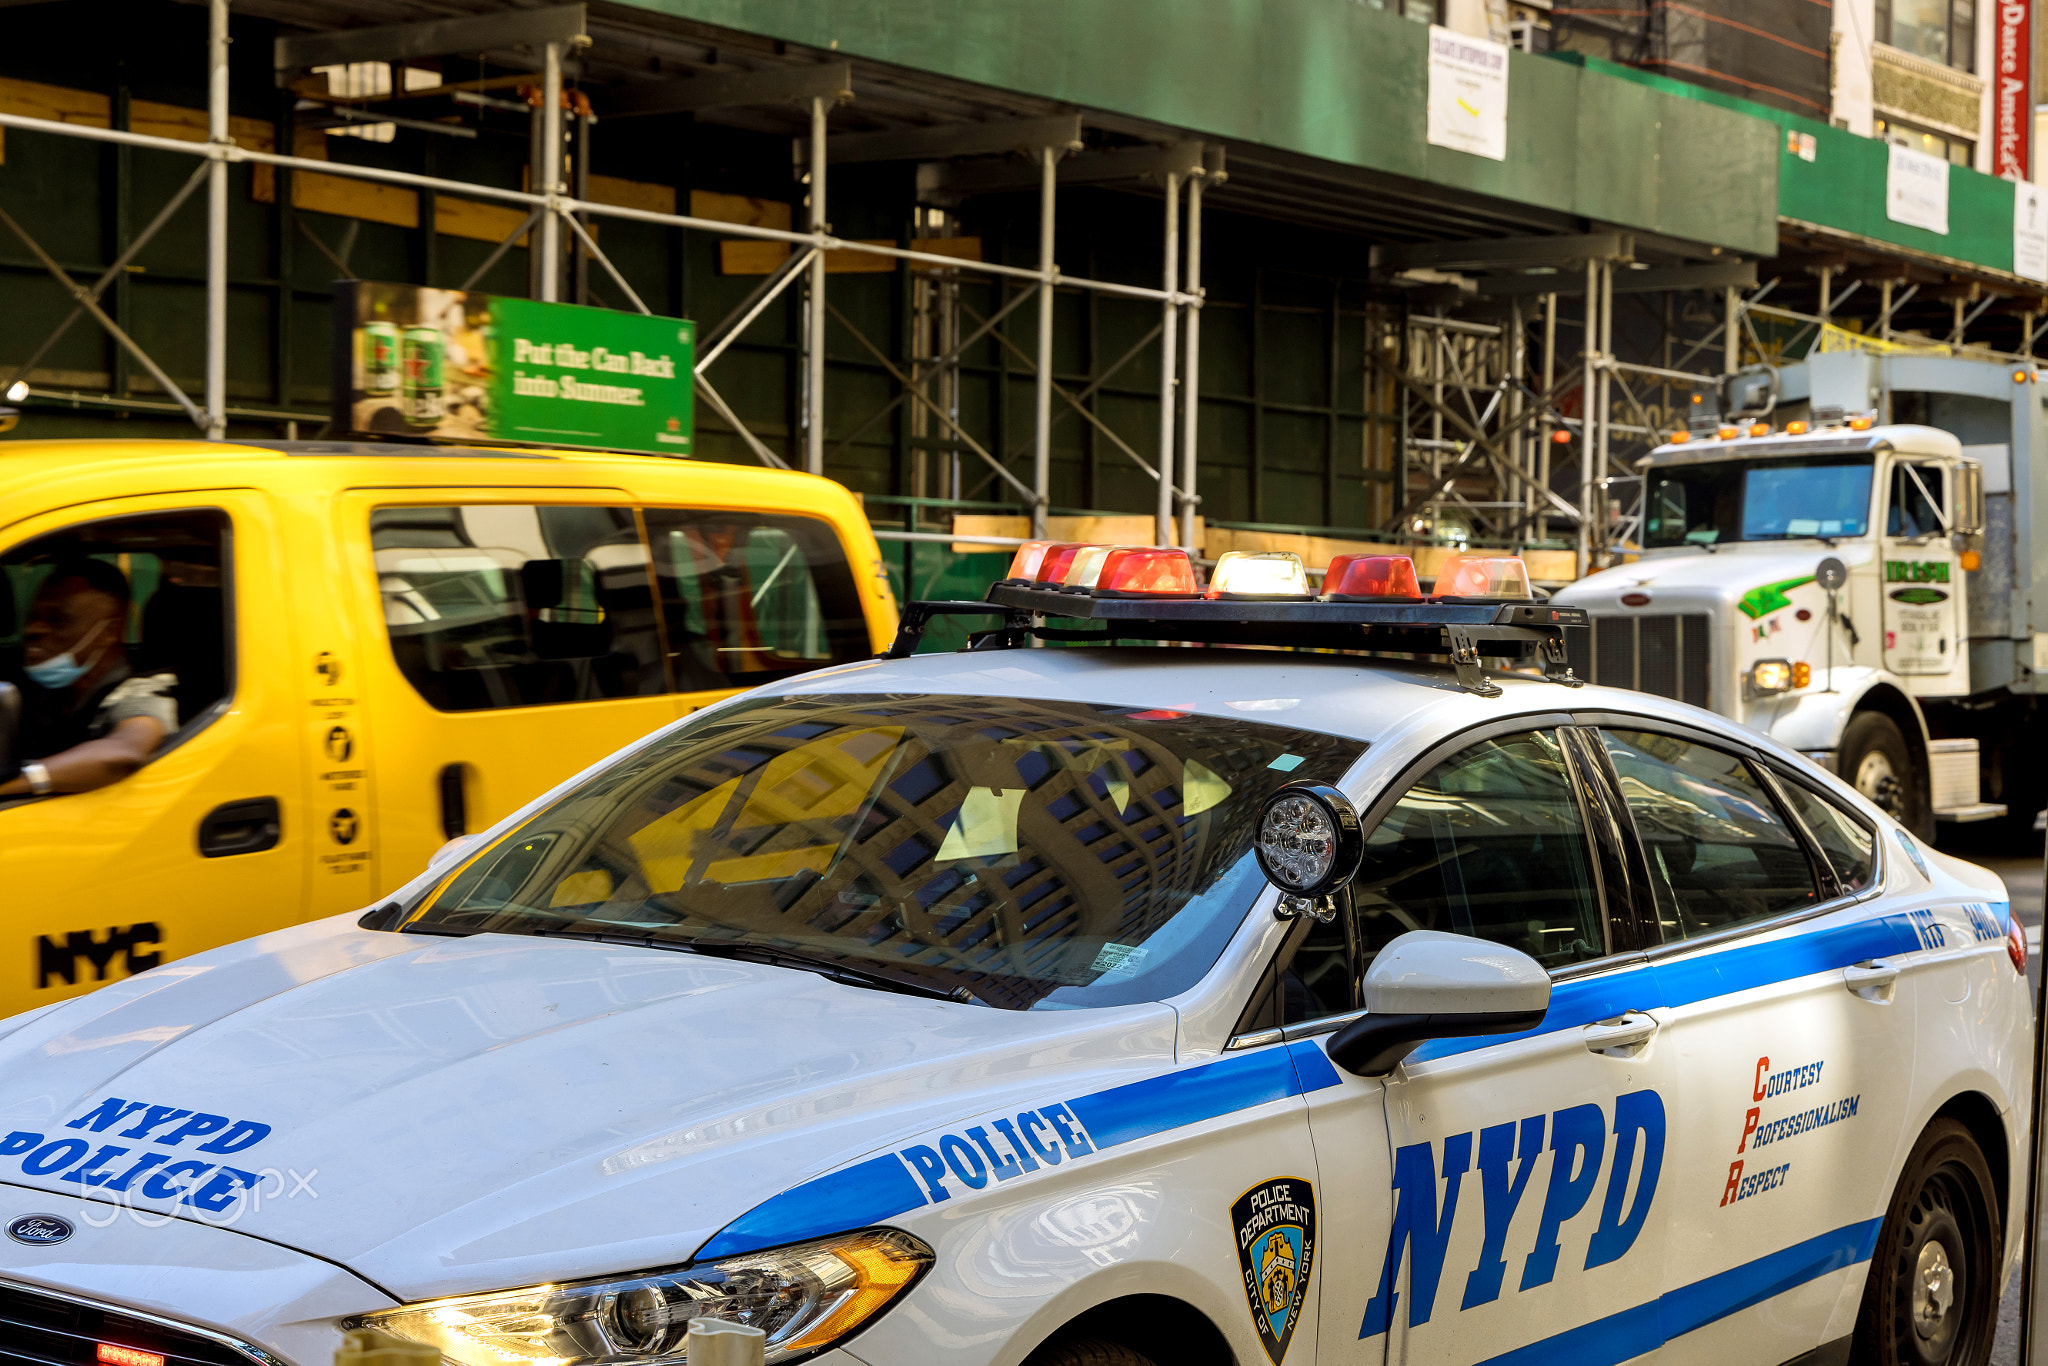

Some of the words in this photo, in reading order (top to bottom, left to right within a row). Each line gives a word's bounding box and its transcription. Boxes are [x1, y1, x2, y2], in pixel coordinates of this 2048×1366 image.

[2000, 77, 2024, 165] America
[514, 338, 553, 365] Put
[554, 343, 590, 370] the
[591, 347, 629, 374] Can
[630, 351, 675, 379] Back
[513, 371, 559, 398] into
[560, 375, 646, 406] Summer.
[1886, 560, 1950, 583] IRISH
[34, 921, 163, 989] NYC
[1753, 1056, 1824, 1102] COURTESY
[65, 1097, 272, 1155] NYPD
[1737, 1094, 1860, 1154] PROFESSIONALISM
[0, 1131, 266, 1213] POLICE
[900, 1103, 1095, 1204] POLICE
[1250, 1184, 1292, 1213] POLICE
[1719, 1159, 1790, 1208] RESPECT
[17, 1219, 61, 1239] Ford
[1240, 1203, 1309, 1250] DEPARTMENT
[1358, 1089, 1667, 1340] NYPD
[1245, 1269, 1261, 1310] CITY
[1257, 1314, 1269, 1335] OF
[1287, 1290, 1302, 1331] NEW
[1300, 1239, 1313, 1283] YORK
